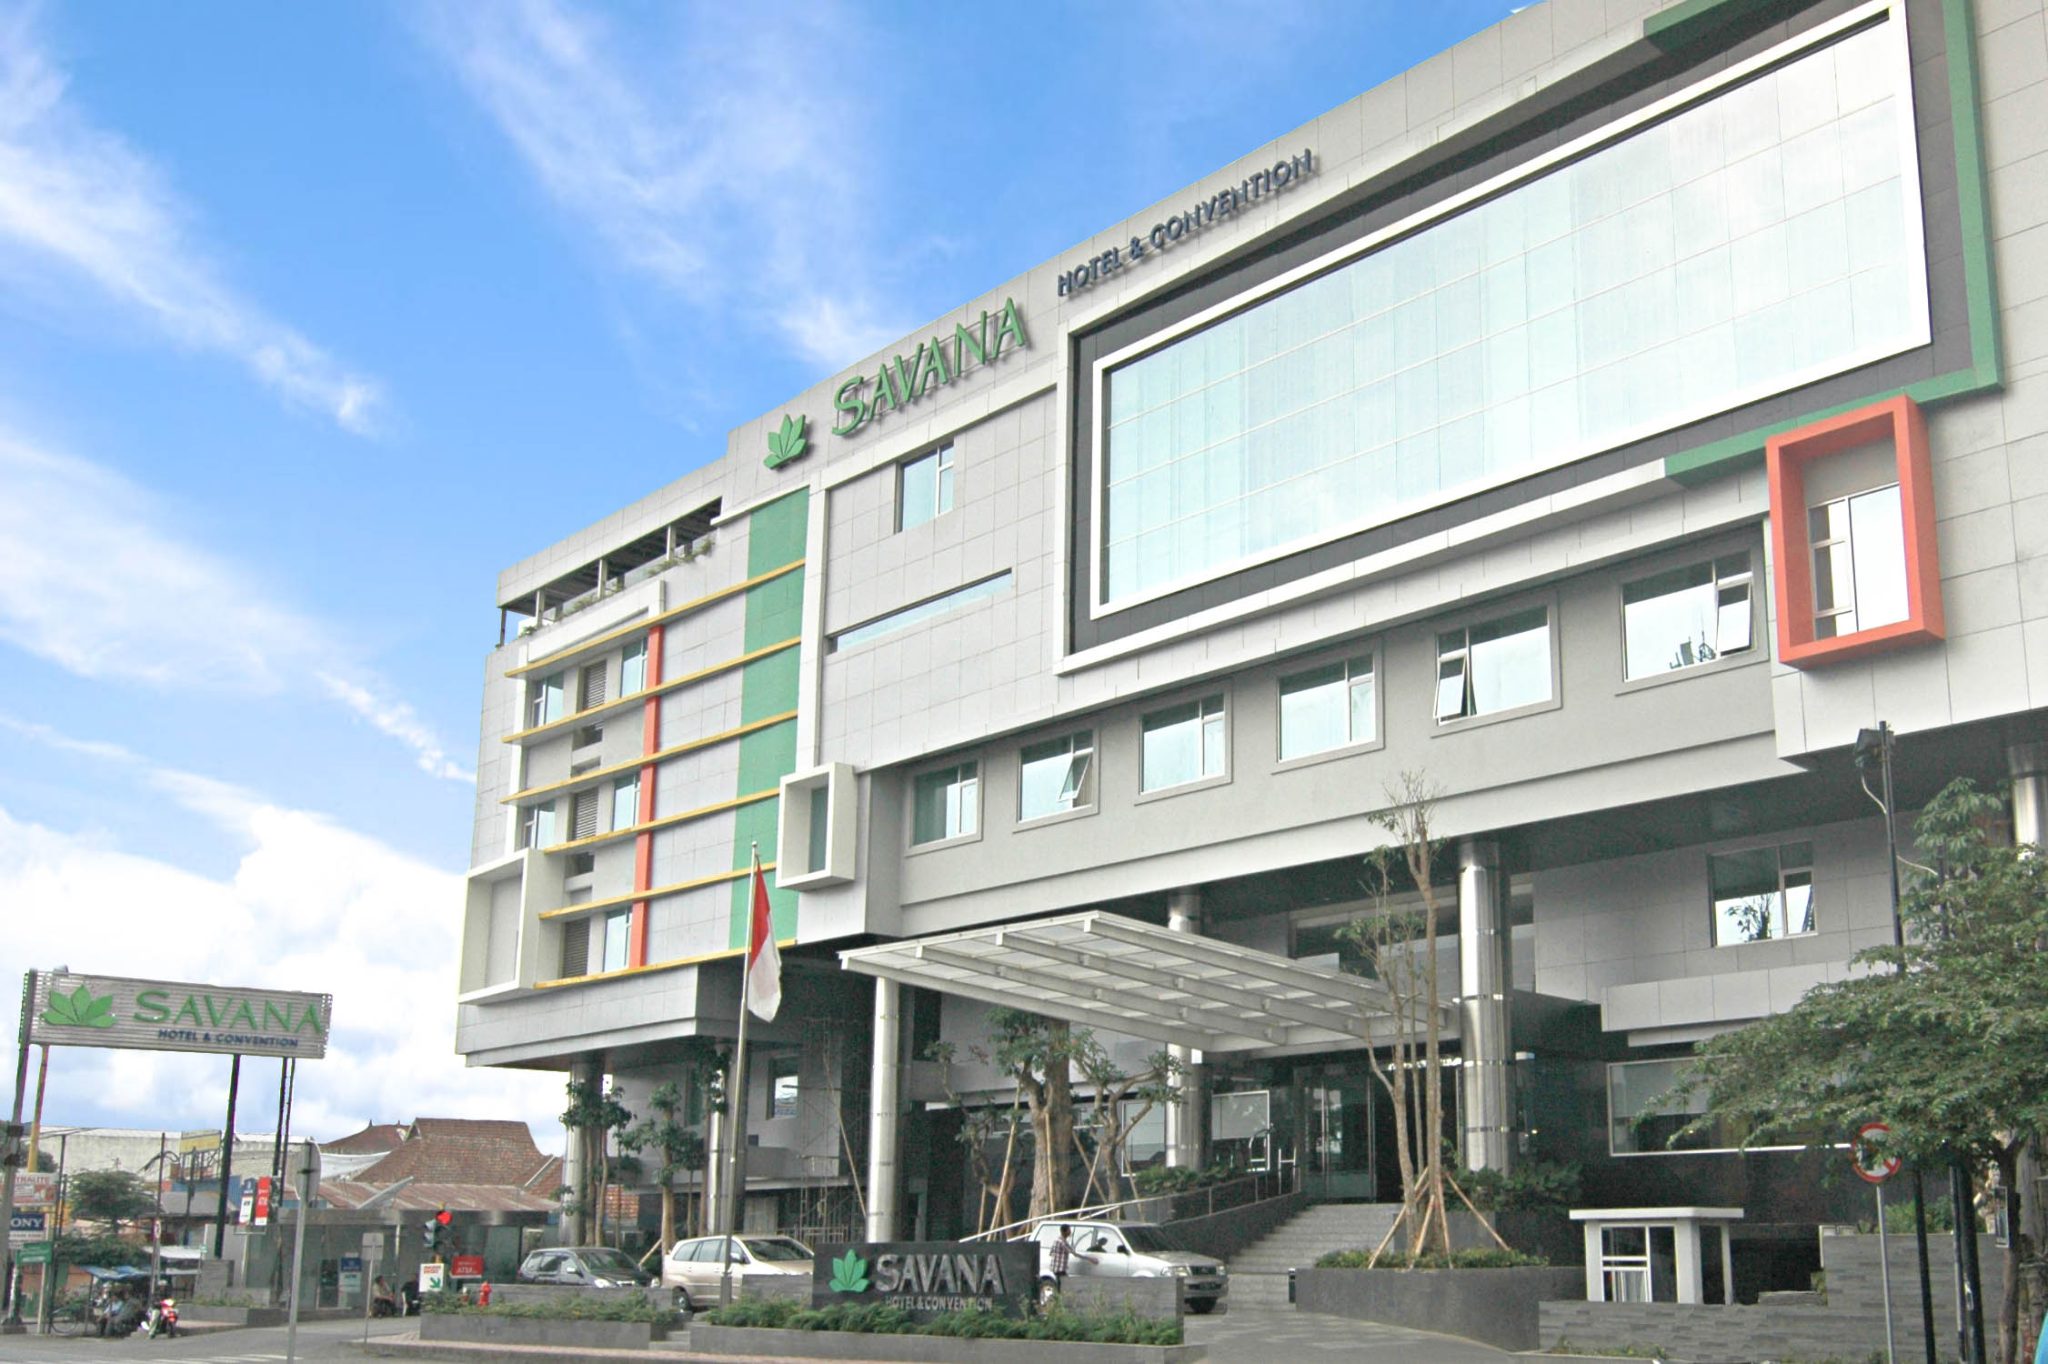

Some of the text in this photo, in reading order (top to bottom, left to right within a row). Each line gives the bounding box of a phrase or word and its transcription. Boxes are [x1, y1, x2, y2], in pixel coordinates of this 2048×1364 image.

[1057, 147, 1313, 297] HOTEL & CONVENTION
[831, 296, 1025, 436] SAVANA
[133, 988, 323, 1035] SAVANA
[158, 1028, 299, 1047] HOTEL & CONVENTION
[10, 1217, 42, 1228] ONY
[875, 1253, 1005, 1295] SAVANA
